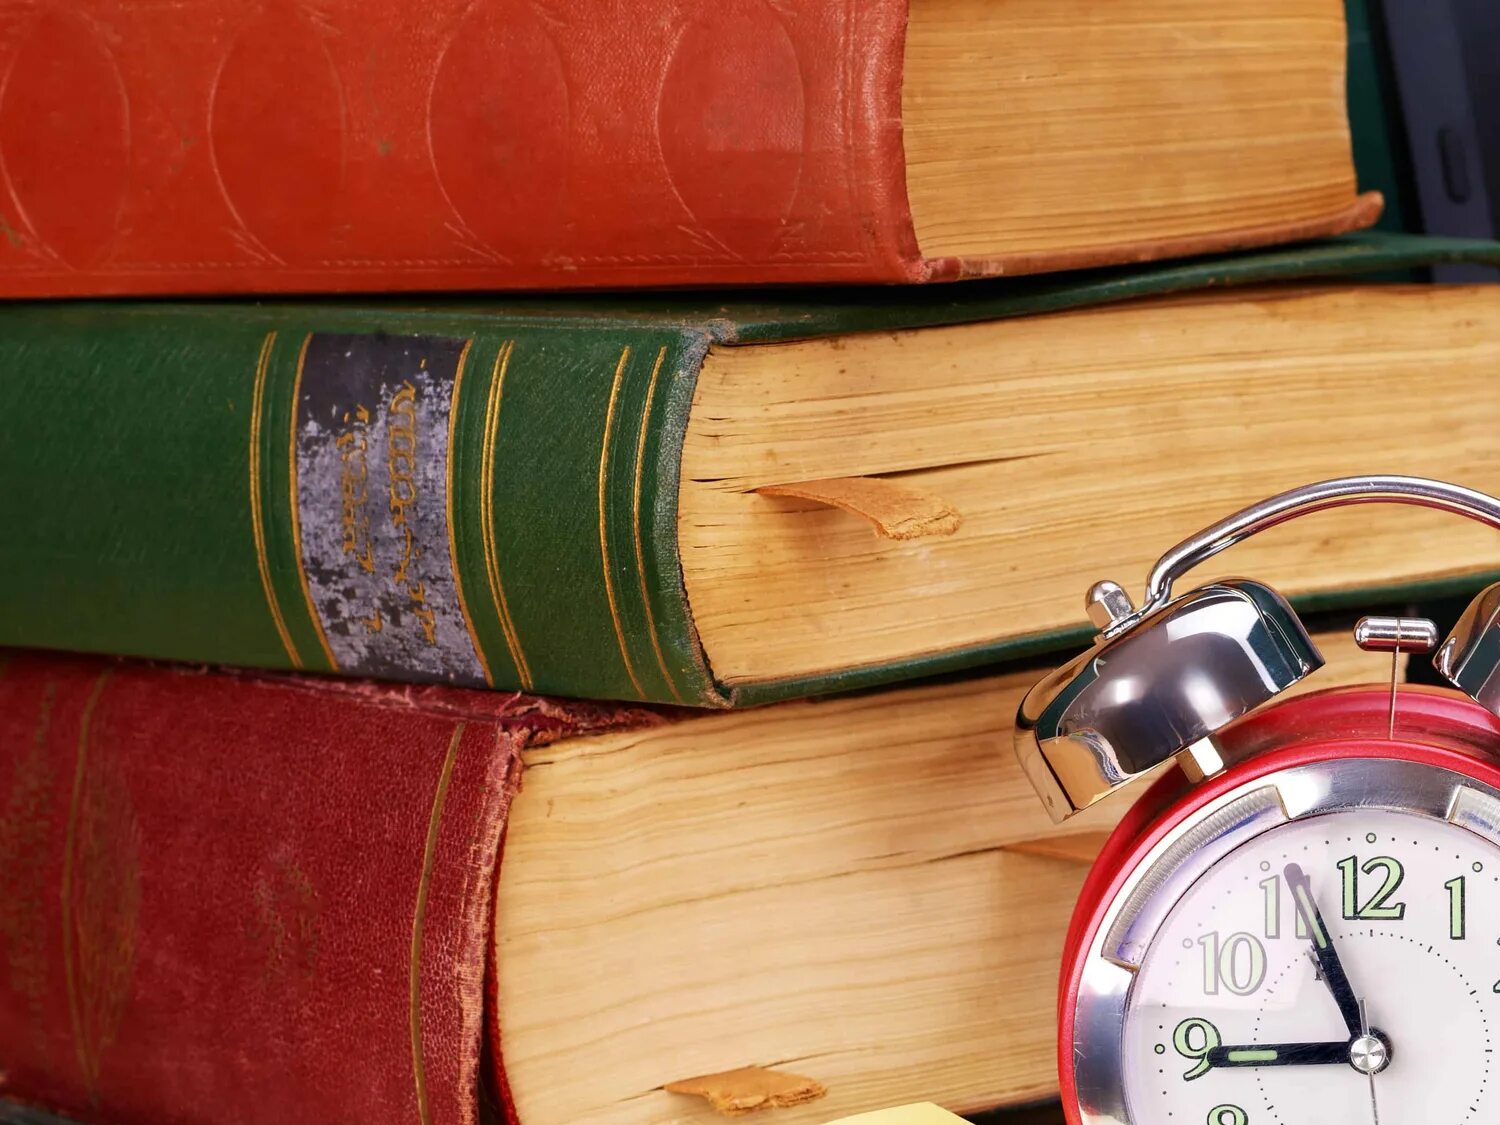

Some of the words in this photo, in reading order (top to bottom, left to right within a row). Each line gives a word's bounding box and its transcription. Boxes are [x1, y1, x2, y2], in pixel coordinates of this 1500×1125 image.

[1337, 855, 1405, 921] 12
[1444, 875, 1466, 941] 1
[1198, 931, 1267, 996] 10
[1172, 1017, 1222, 1081] 9
